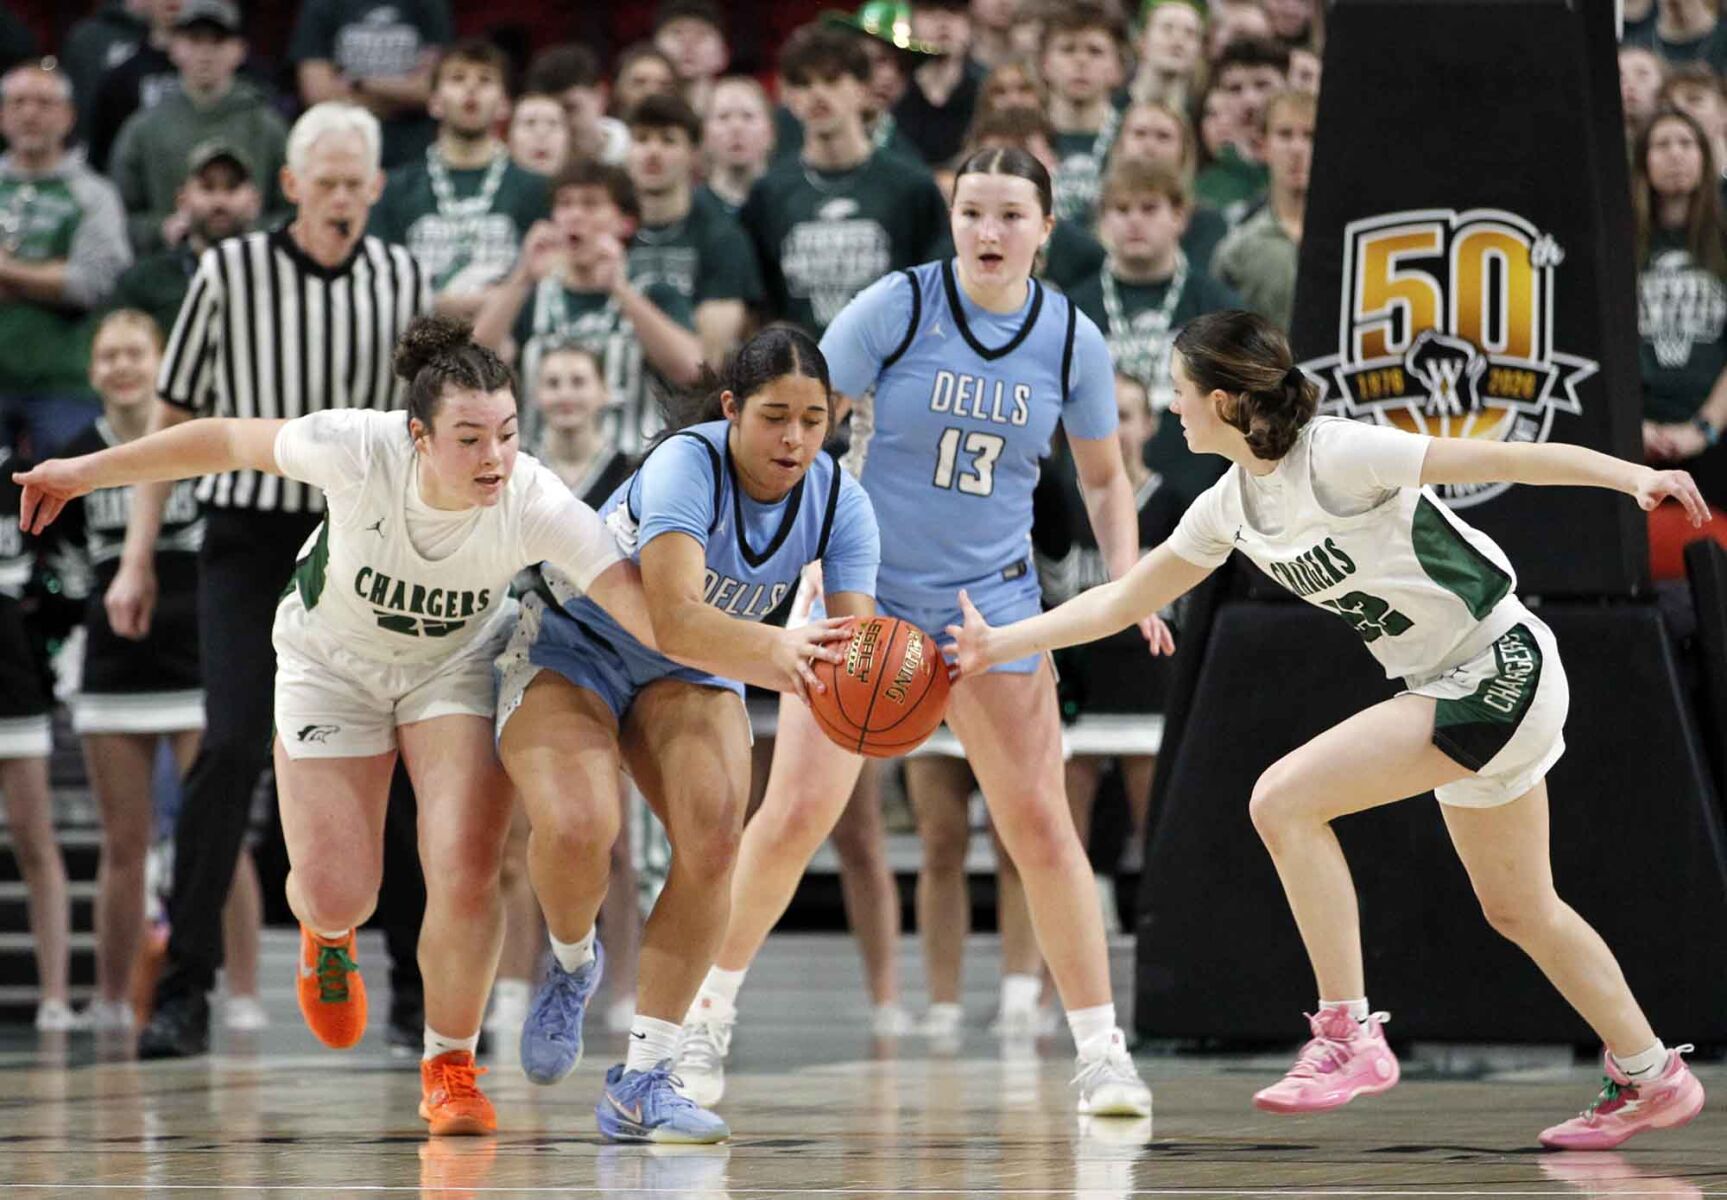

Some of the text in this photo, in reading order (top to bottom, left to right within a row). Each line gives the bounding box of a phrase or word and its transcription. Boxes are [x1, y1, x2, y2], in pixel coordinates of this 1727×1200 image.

[930, 369, 1031, 427] DELLS
[932, 427, 1007, 497] 13
[354, 565, 491, 620] CHARGERS
[703, 566, 788, 617] DELLS
[856, 618, 888, 684] LEGACY
